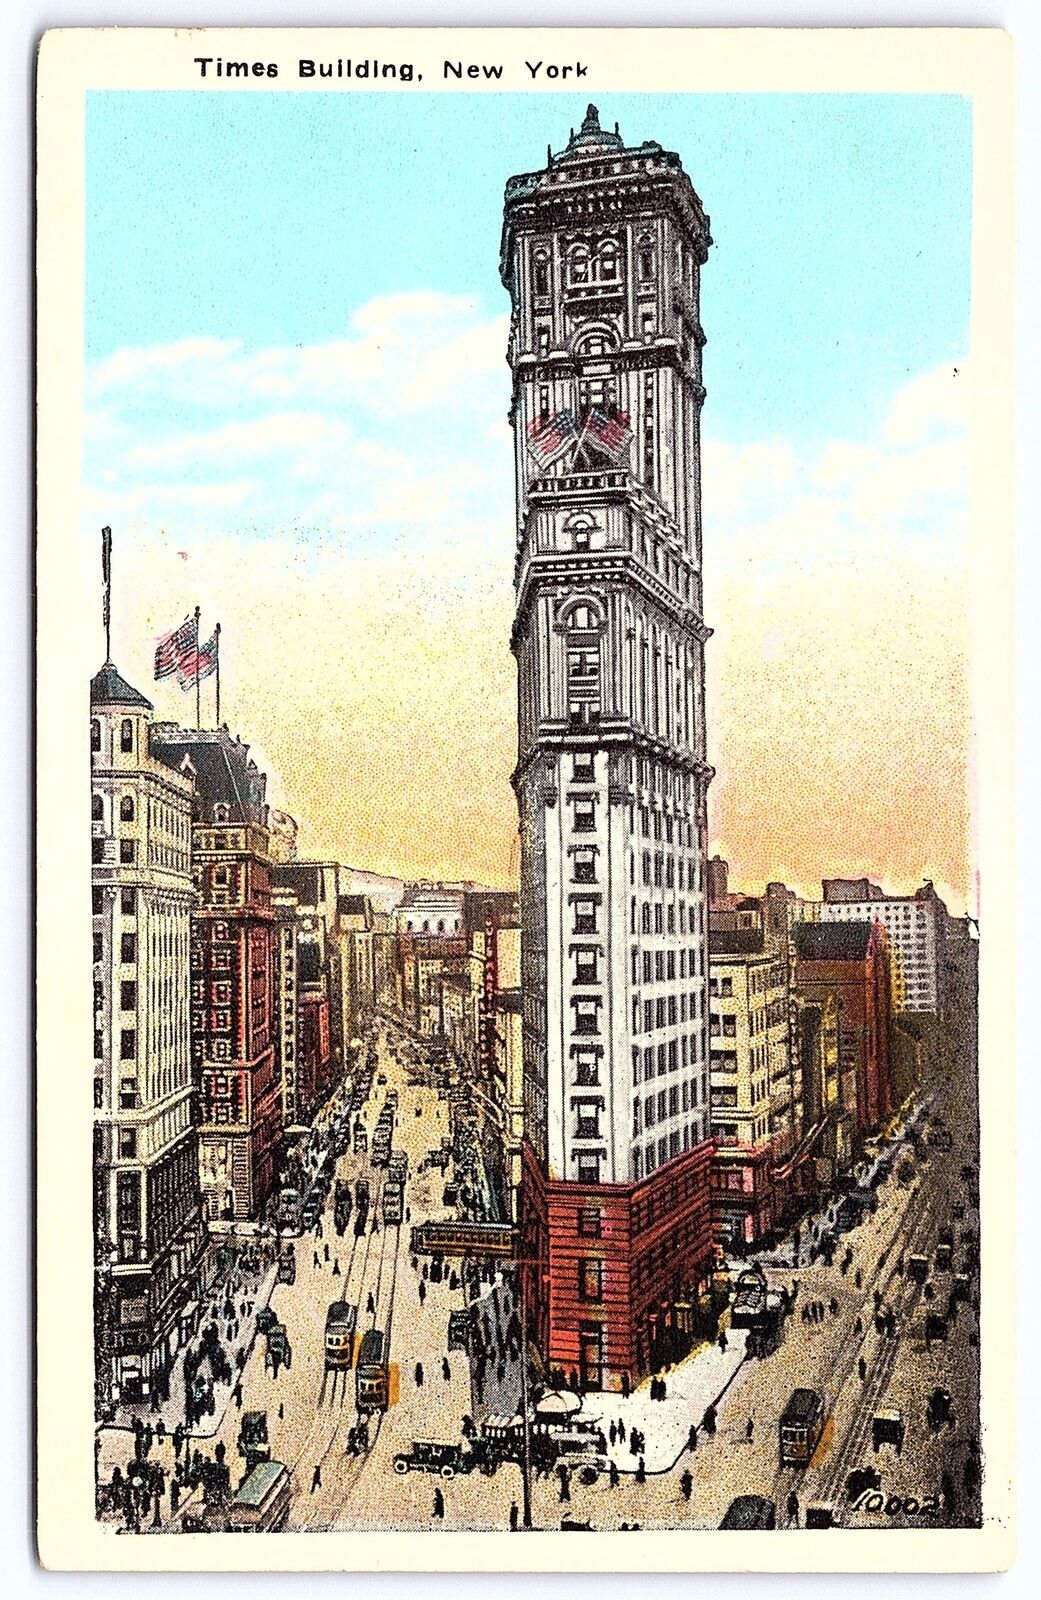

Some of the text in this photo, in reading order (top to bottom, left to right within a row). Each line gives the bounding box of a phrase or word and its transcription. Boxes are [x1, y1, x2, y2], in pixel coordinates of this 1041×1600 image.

[193, 57, 588, 82] Times Building, New York
